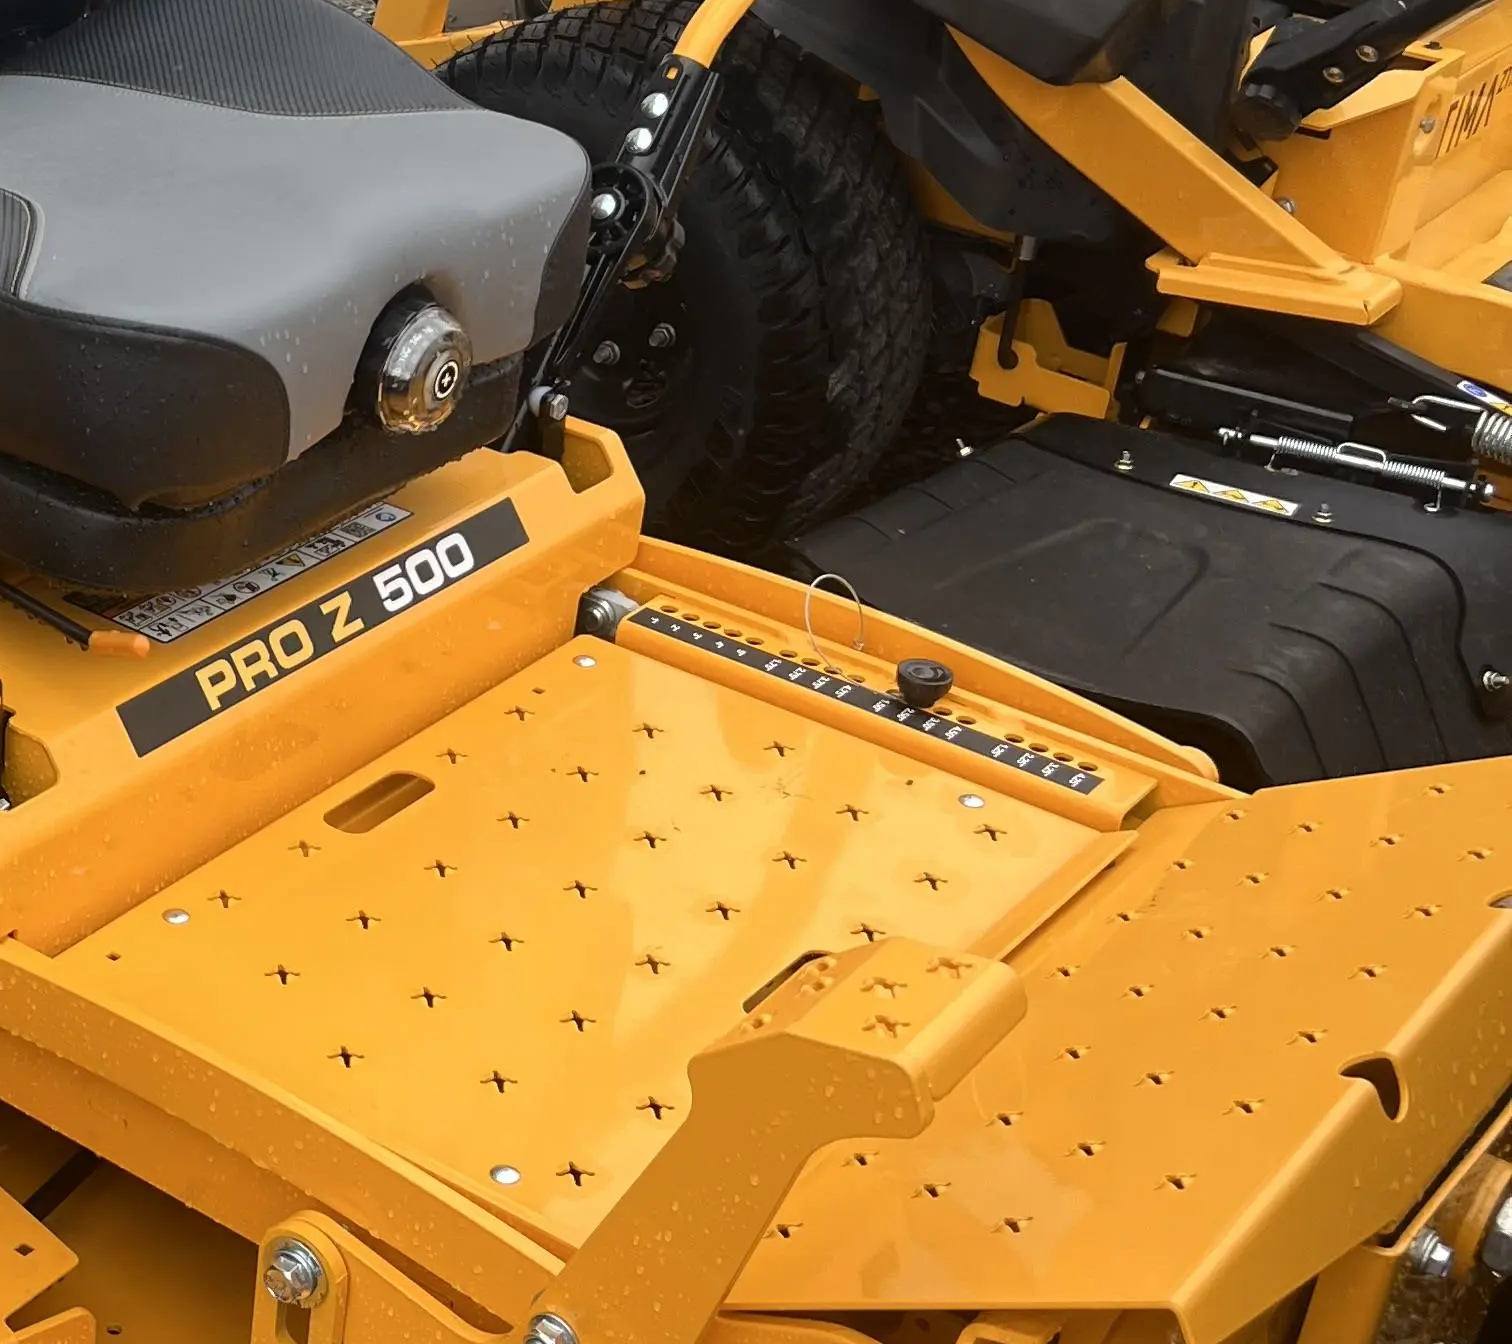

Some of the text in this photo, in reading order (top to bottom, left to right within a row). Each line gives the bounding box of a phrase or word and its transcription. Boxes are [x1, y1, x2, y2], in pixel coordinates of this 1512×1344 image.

[195, 532, 475, 711] PRO Z 500
